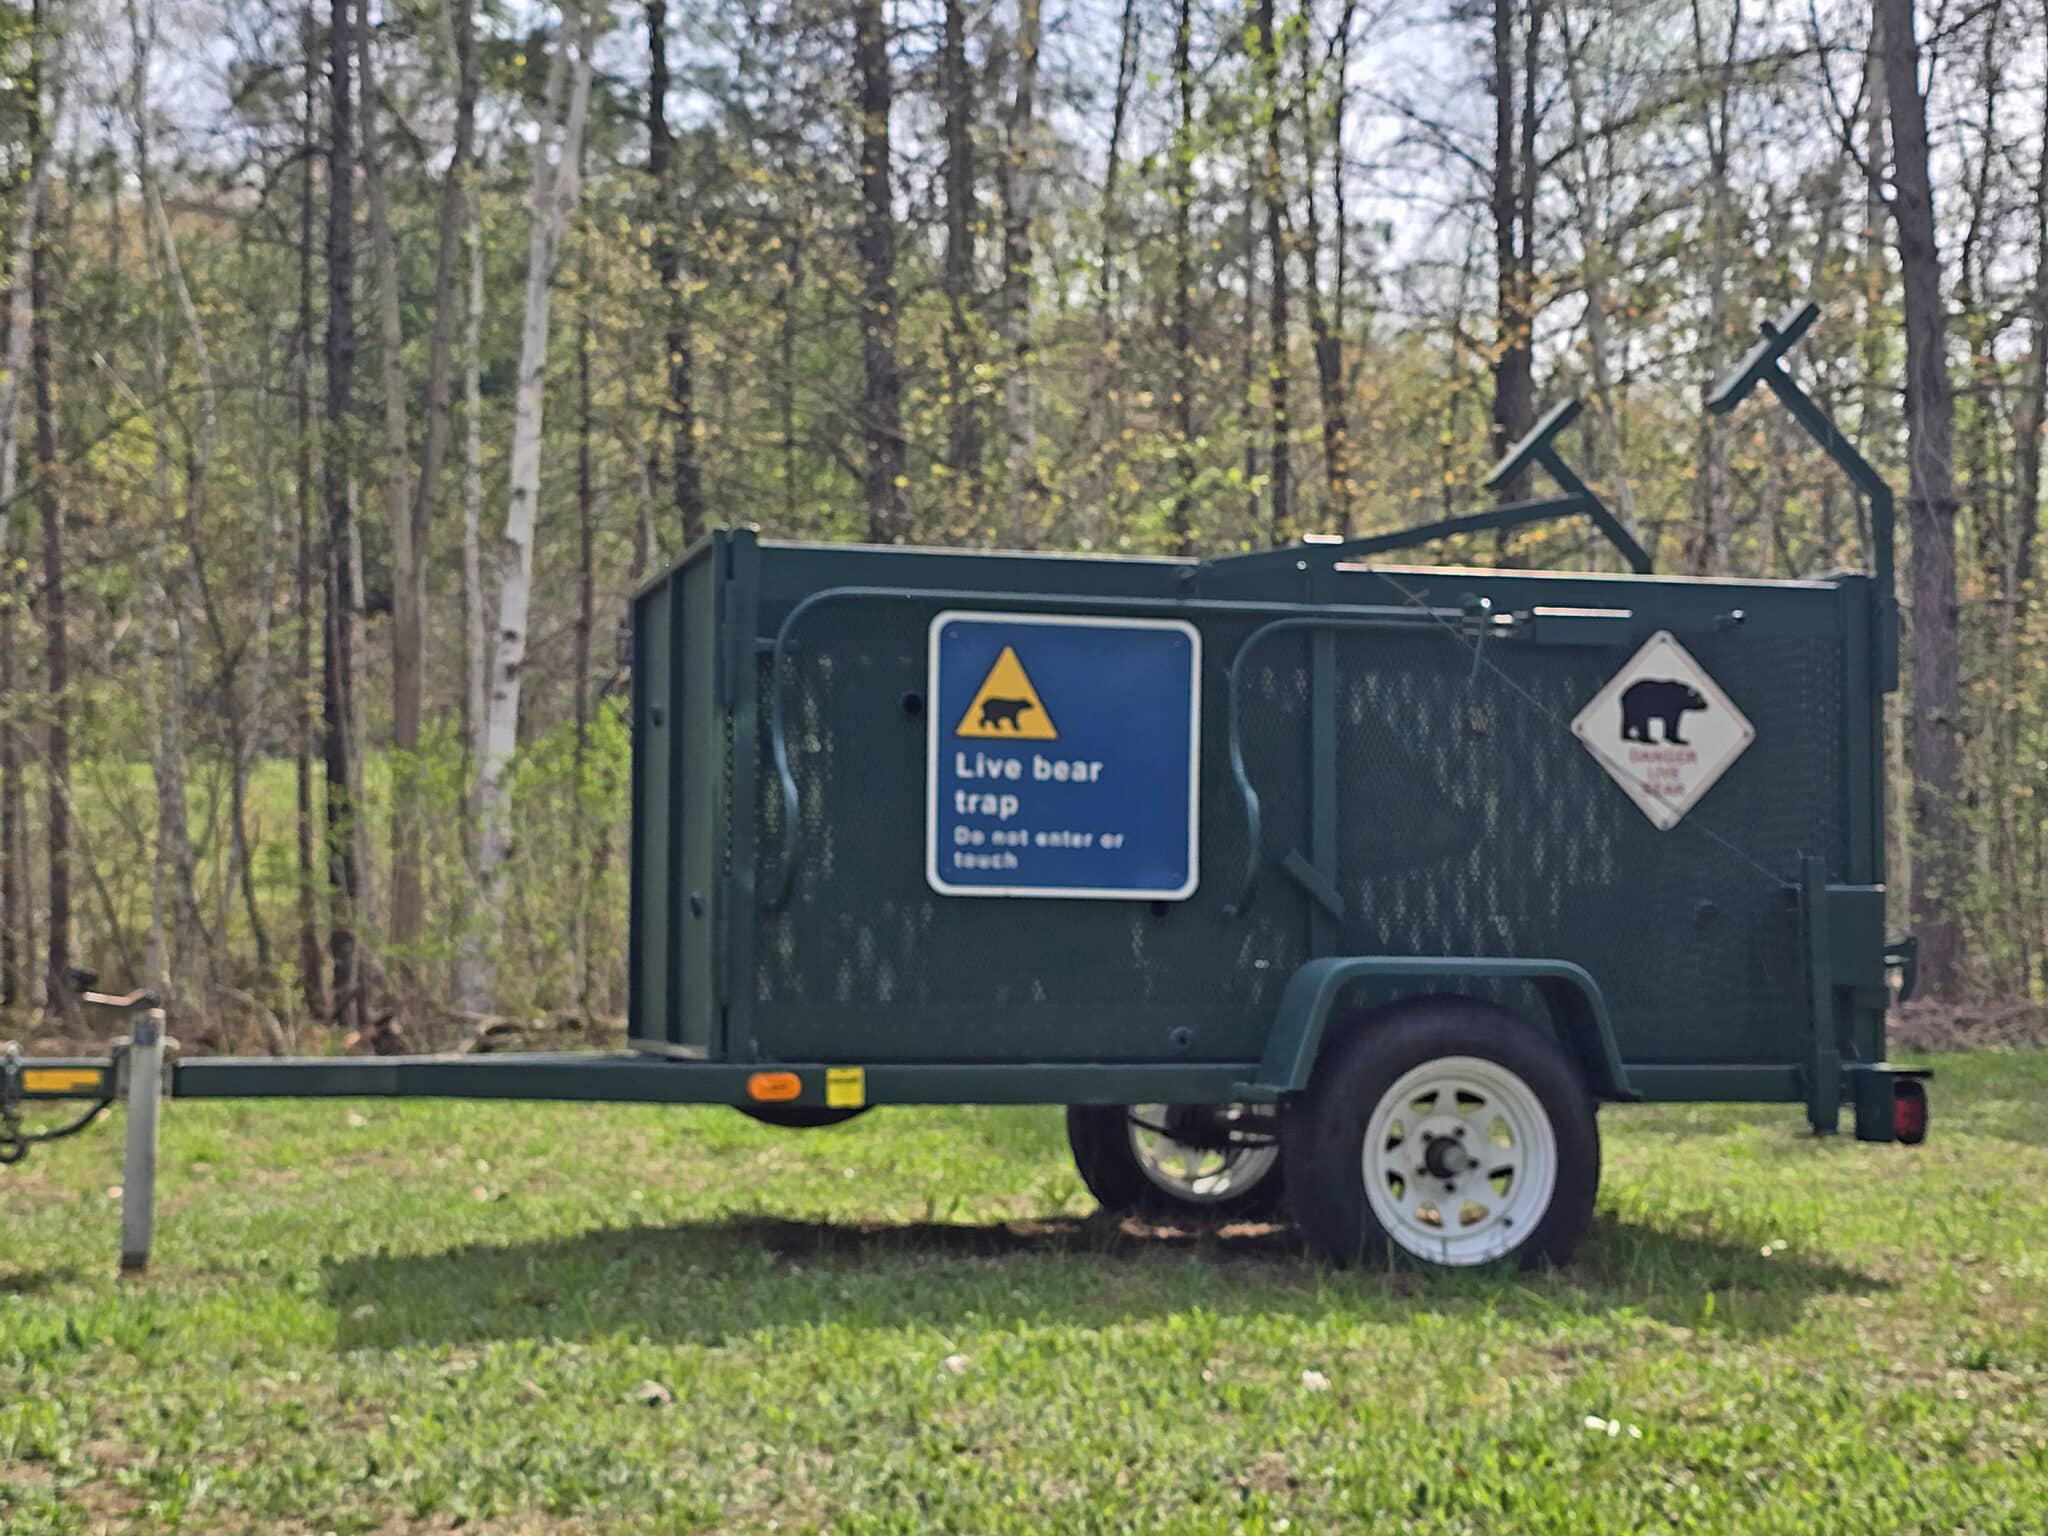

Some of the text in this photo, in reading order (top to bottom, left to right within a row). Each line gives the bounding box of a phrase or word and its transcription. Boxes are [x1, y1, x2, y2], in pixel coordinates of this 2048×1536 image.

[955, 751, 1104, 782] Live bear
[1630, 750, 1697, 763] DANGER
[954, 789, 1019, 821] trap
[954, 826, 1125, 850] Do not enter or
[954, 851, 1018, 870] touch
